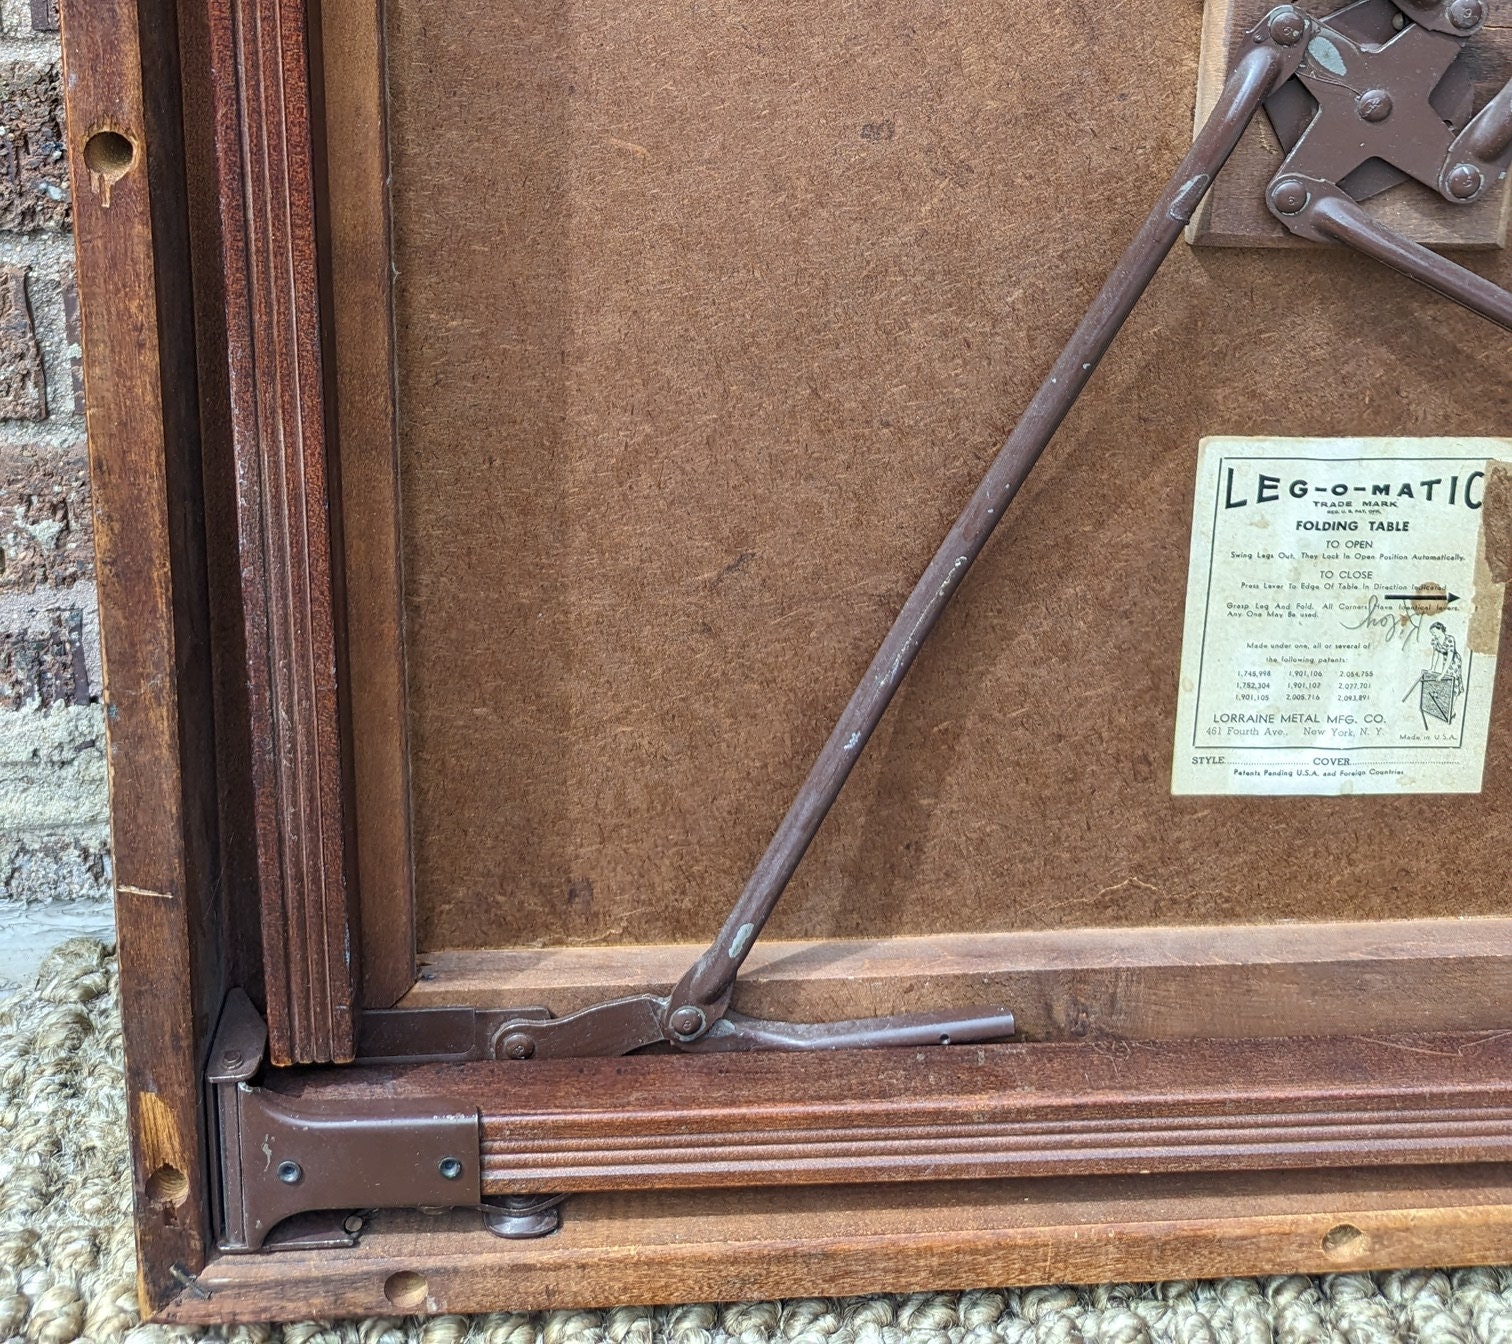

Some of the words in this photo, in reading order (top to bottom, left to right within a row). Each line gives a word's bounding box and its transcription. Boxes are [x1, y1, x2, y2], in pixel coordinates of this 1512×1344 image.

[1225, 466, 1485, 509] LEG-O-MATIC
[1313, 500, 1353, 508] TRADE
[1362, 500, 1398, 508] MARK
[1296, 520, 1359, 531] FOLDING
[1368, 521, 1410, 531] TABLE
[1326, 540, 1340, 549] TO
[1345, 540, 1373, 549] OPEN
[1230, 551, 1253, 560] Swing
[1257, 552, 1274, 560] Legs
[1301, 552, 1318, 561] They
[1411, 553, 1466, 561] Automatically.
[1320, 570, 1334, 579] TO
[1339, 570, 1373, 579] CLOSE
[1226, 602, 1250, 610] Grasp
[1255, 603, 1269, 611] Leg
[1266, 611, 1283, 619] May
[1281, 656, 1315, 664] following
[1213, 713, 1275, 724] LORRAINE
[1280, 713, 1320, 723] METAL
[1327, 715, 1358, 725] MFG.
[1363, 714, 1387, 724] CO.
[1206, 727, 1222, 736] 461
[1227, 726, 1259, 736] Fourth
[1303, 727, 1326, 736] New
[1331, 728, 1355, 737] York,
[1360, 727, 1370, 736] N.
[1375, 727, 1385, 736] Y.
[1191, 756, 1225, 765] STYLE
[1313, 758, 1351, 766] COVER
[1263, 769, 1293, 777] Pending
[1340, 769, 1366, 777] Foreign
